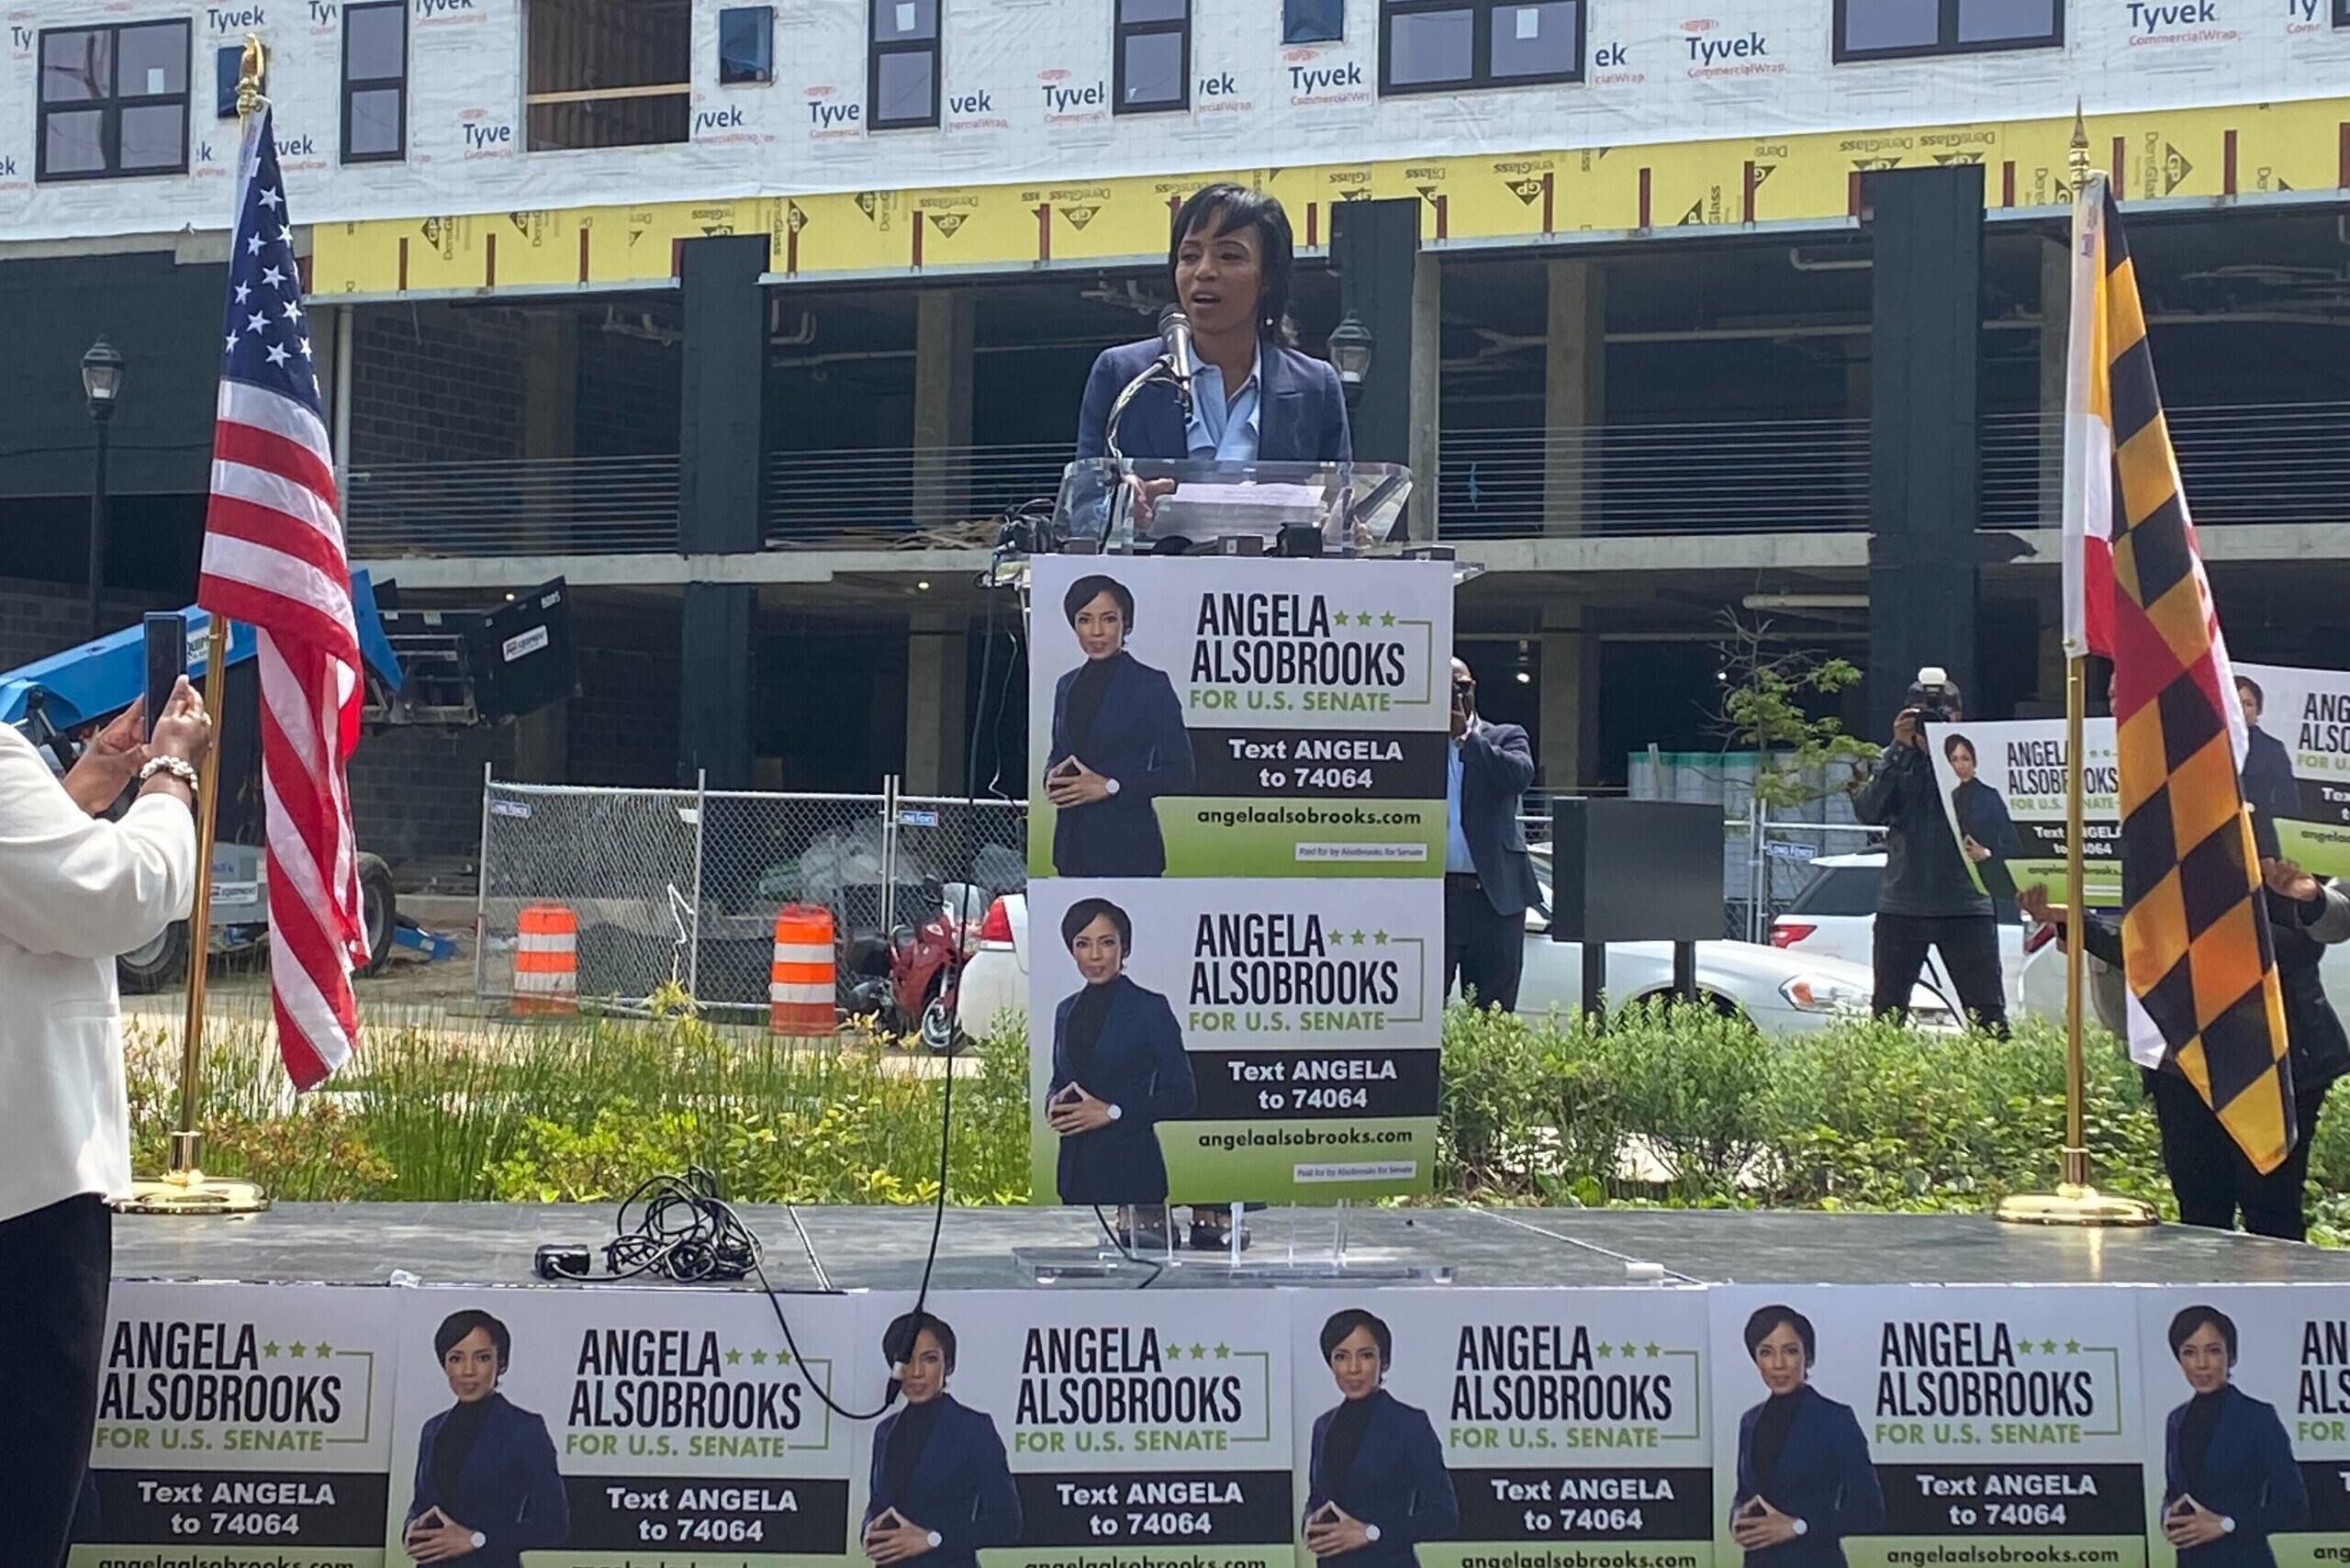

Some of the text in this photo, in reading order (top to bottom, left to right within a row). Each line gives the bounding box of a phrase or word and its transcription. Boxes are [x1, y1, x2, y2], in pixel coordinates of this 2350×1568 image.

[207, 6, 264, 33] Tyvek
[2127, 1, 2216, 34] Tyvek
[1685, 32, 1767, 66] Tyvek
[2130, 29, 2237, 46] CommercialWrap
[1288, 62, 1362, 95] Tyvek
[1687, 62, 1785, 79] CommercialWrap
[949, 89, 991, 113] vek
[809, 100, 860, 129] Tyve
[463, 123, 510, 149] Tyve
[1840, 137, 1914, 152] DensGlass
[1920, 131, 1996, 148] DensGlass
[1516, 180, 1542, 196] GP
[938, 215, 961, 230] GP
[1069, 207, 1092, 222] GP
[1197, 593, 1330, 637] ANGELA
[1191, 640, 1405, 686] ALSOBROOKS
[1190, 689, 1391, 711] FOR U.S. SENATE
[1228, 738, 1403, 760] Text ANGELA
[2297, 755, 2328, 768] FOR
[1259, 768, 1372, 789] to 74064
[2010, 798, 2035, 810] FOR
[2040, 798, 2063, 810] U.S.
[1197, 807, 1421, 827] angelaalsobrooks.com
[2033, 825, 2065, 838] Text
[1194, 913, 1326, 958] ANGELA
[1190, 960, 1398, 1005] ALSOBROOKS
[1189, 1011, 1385, 1031] FOR U.S. SENATE
[1227, 1059, 1397, 1081] Text ANGELA
[1259, 1088, 1368, 1110] to 74064
[1199, 1128, 1413, 1150] angelaalsobrooks.com
[108, 1321, 259, 1371] ANGELA
[576, 1329, 722, 1377] ANGELA
[1022, 1327, 1163, 1374] ANGELA
[1456, 1326, 1594, 1372] ANGELA
[1880, 1321, 2017, 1368] ANGELA
[98, 1372, 341, 1423] ALSOBROOKS
[567, 1380, 801, 1430] ALSOBROOKS
[1015, 1375, 1242, 1425] ALSOBROOKS
[1450, 1374, 1672, 1421] ALSOBROOKS
[1875, 1371, 2094, 1417] ALSOBROOKS
[96, 1427, 323, 1451] FOR U.S. SENATE
[1015, 1429, 1228, 1452] FOR U.S. SENATE
[1449, 1427, 1658, 1449] FOR U.S. SENATE
[1875, 1423, 2082, 1444] FOR U.S. SENATE
[2298, 1421, 2346, 1441] FOR
[566, 1434, 785, 1458] FOR U.S. SENATE
[138, 1481, 336, 1506] Text ANGELA
[1056, 1481, 1244, 1506] Text ANGELA
[1491, 1479, 1674, 1501] Text ANGELA
[1917, 1474, 2098, 1496] Text ANGELA
[606, 1486, 799, 1512] Text ANGELA
[171, 1513, 300, 1535] to 74064
[1089, 1512, 1213, 1536] to 74064
[1524, 1508, 1643, 1531] to 74064
[1949, 1504, 2066, 1526] to 74064
[639, 1519, 764, 1542] to 74064
[1461, 1550, 1696, 1568] angelaalsobrooks.com
[1887, 1544, 2120, 1567] angelaalsobrooks.com
